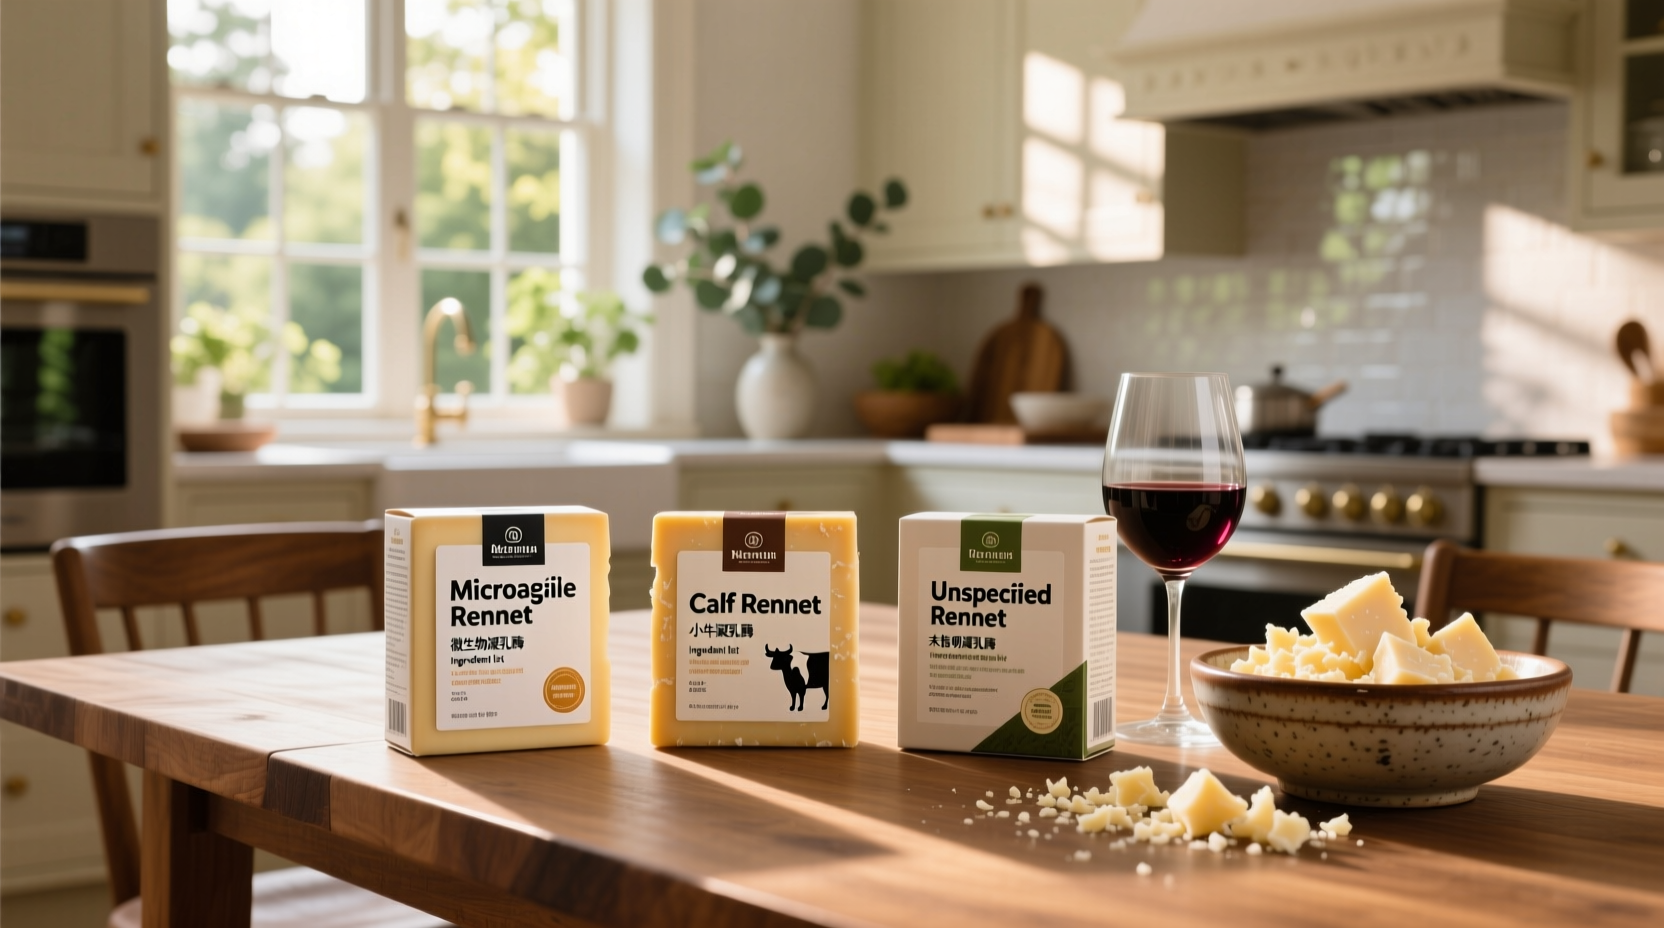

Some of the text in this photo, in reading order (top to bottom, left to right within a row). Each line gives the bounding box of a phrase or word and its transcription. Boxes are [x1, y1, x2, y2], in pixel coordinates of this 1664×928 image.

[689, 592, 822, 614] Calf Rennet
[451, 606, 534, 627] Rennet
[931, 606, 1007, 628] Rennet
